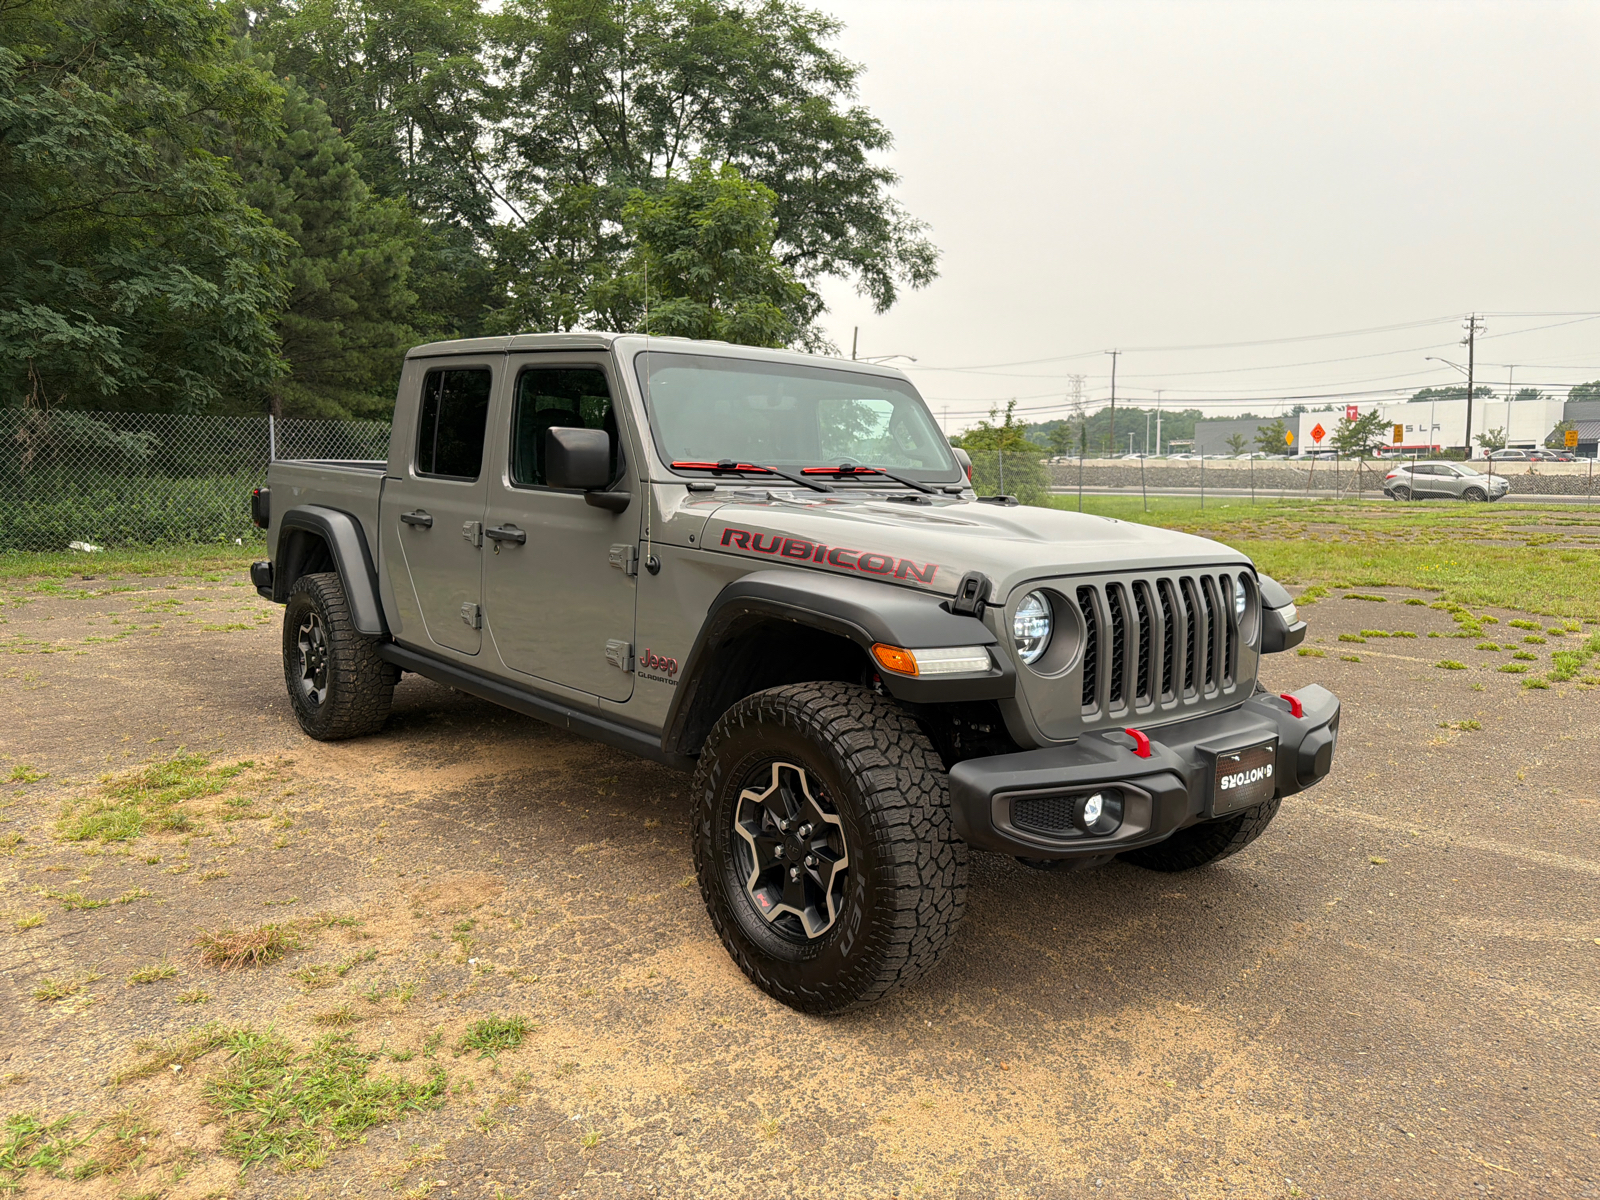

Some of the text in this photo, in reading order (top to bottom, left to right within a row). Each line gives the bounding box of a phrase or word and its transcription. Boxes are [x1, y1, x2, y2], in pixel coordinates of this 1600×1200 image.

[720, 527, 939, 585] RUBICON
[639, 647, 678, 677] Jeep
[637, 671, 679, 686] GLADIATOR
